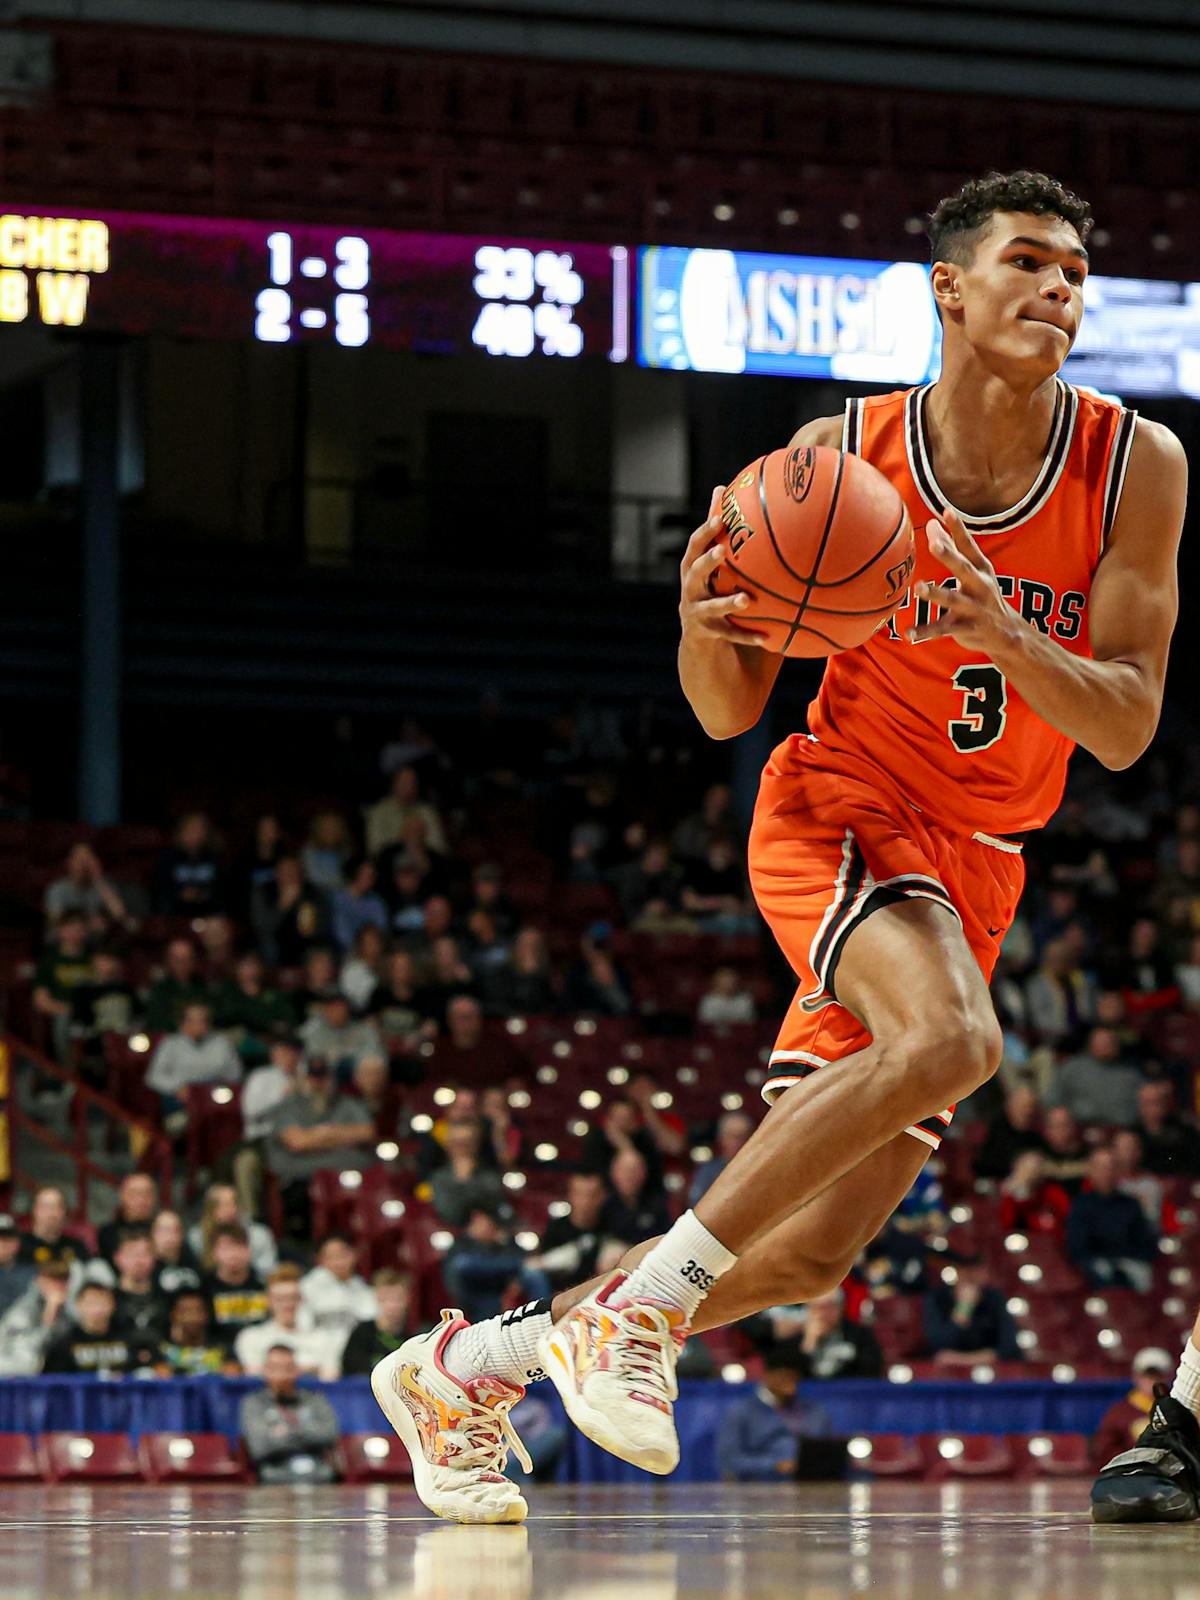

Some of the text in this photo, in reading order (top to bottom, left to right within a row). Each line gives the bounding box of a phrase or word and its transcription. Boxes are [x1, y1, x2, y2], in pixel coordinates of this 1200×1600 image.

[36, 271, 90, 326] W
[473, 246, 584, 304] 33%
[947, 663, 1007, 754] 3
